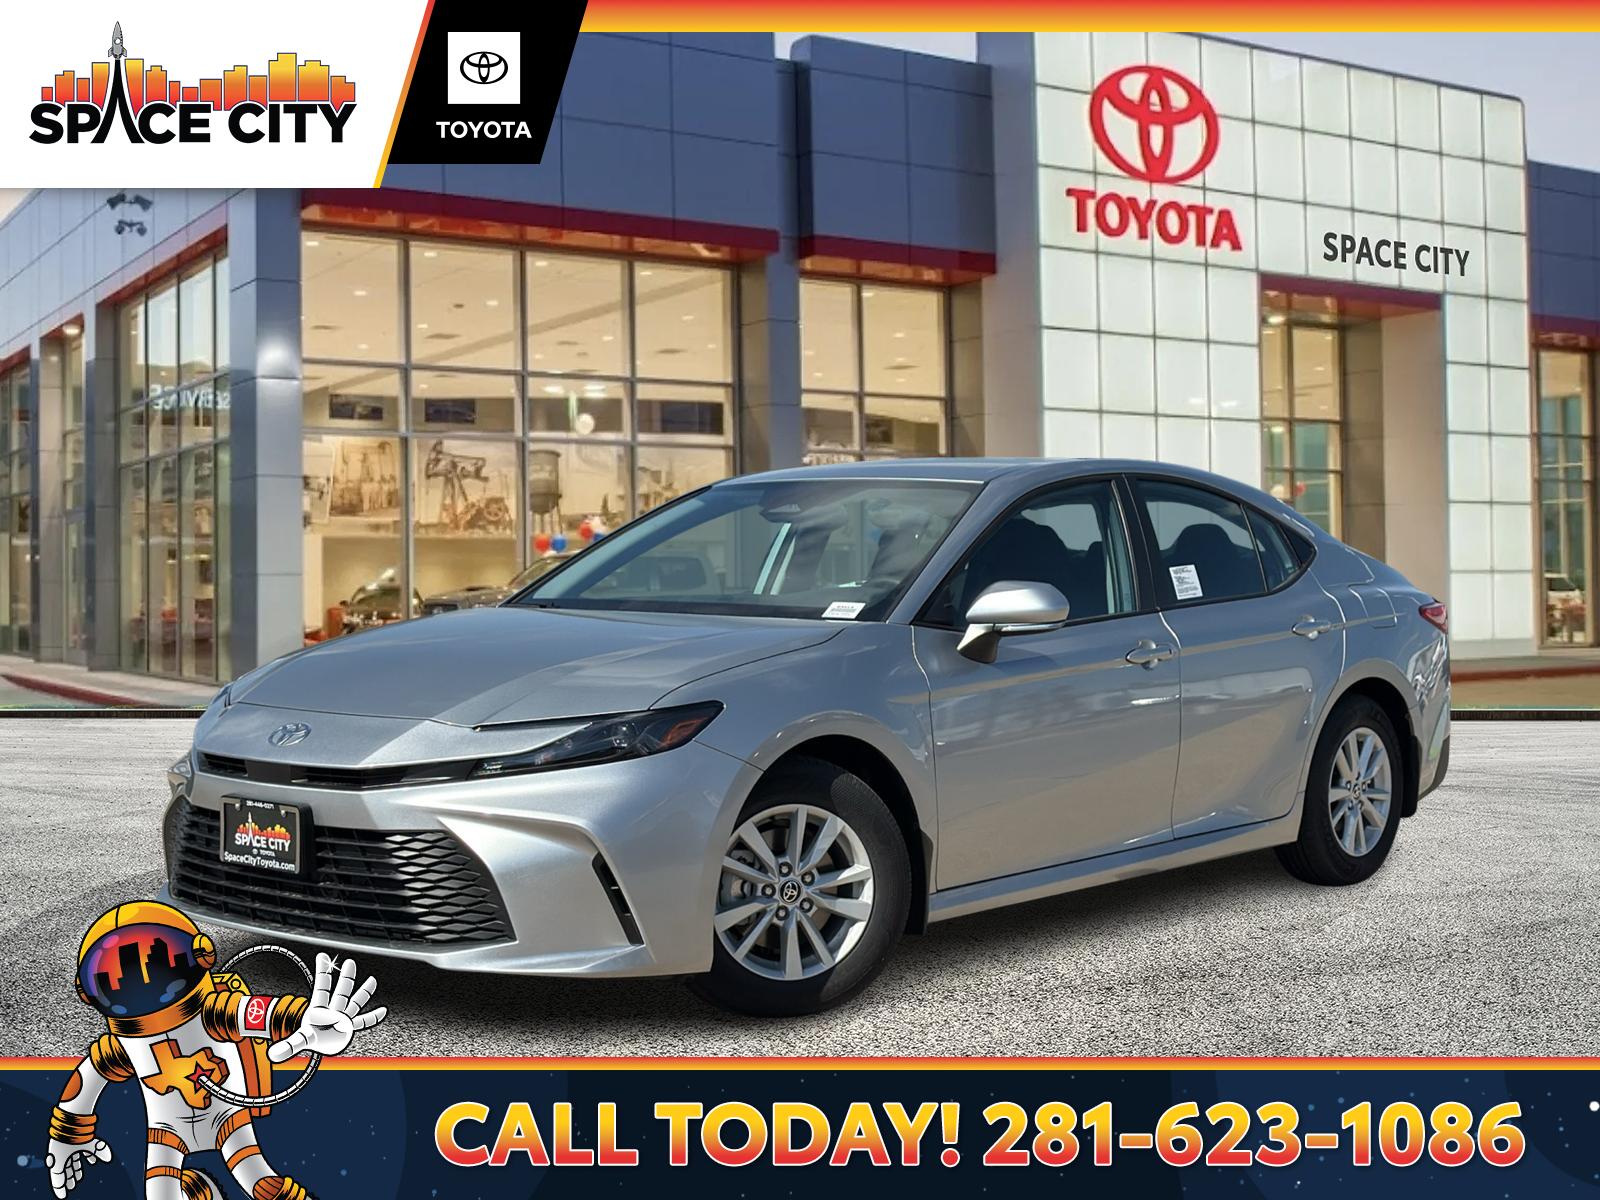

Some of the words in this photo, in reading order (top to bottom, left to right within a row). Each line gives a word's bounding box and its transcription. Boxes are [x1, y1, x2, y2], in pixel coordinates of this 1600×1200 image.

[1066, 187, 1242, 252] TOYOTA
[1323, 232, 1407, 270] SPACE
[1415, 243, 1470, 277] CITY
[260, 849, 275, 857] TOYOTA
[268, 837, 291, 851] CITY
[224, 851, 295, 871] SpaceCityToyota.com
